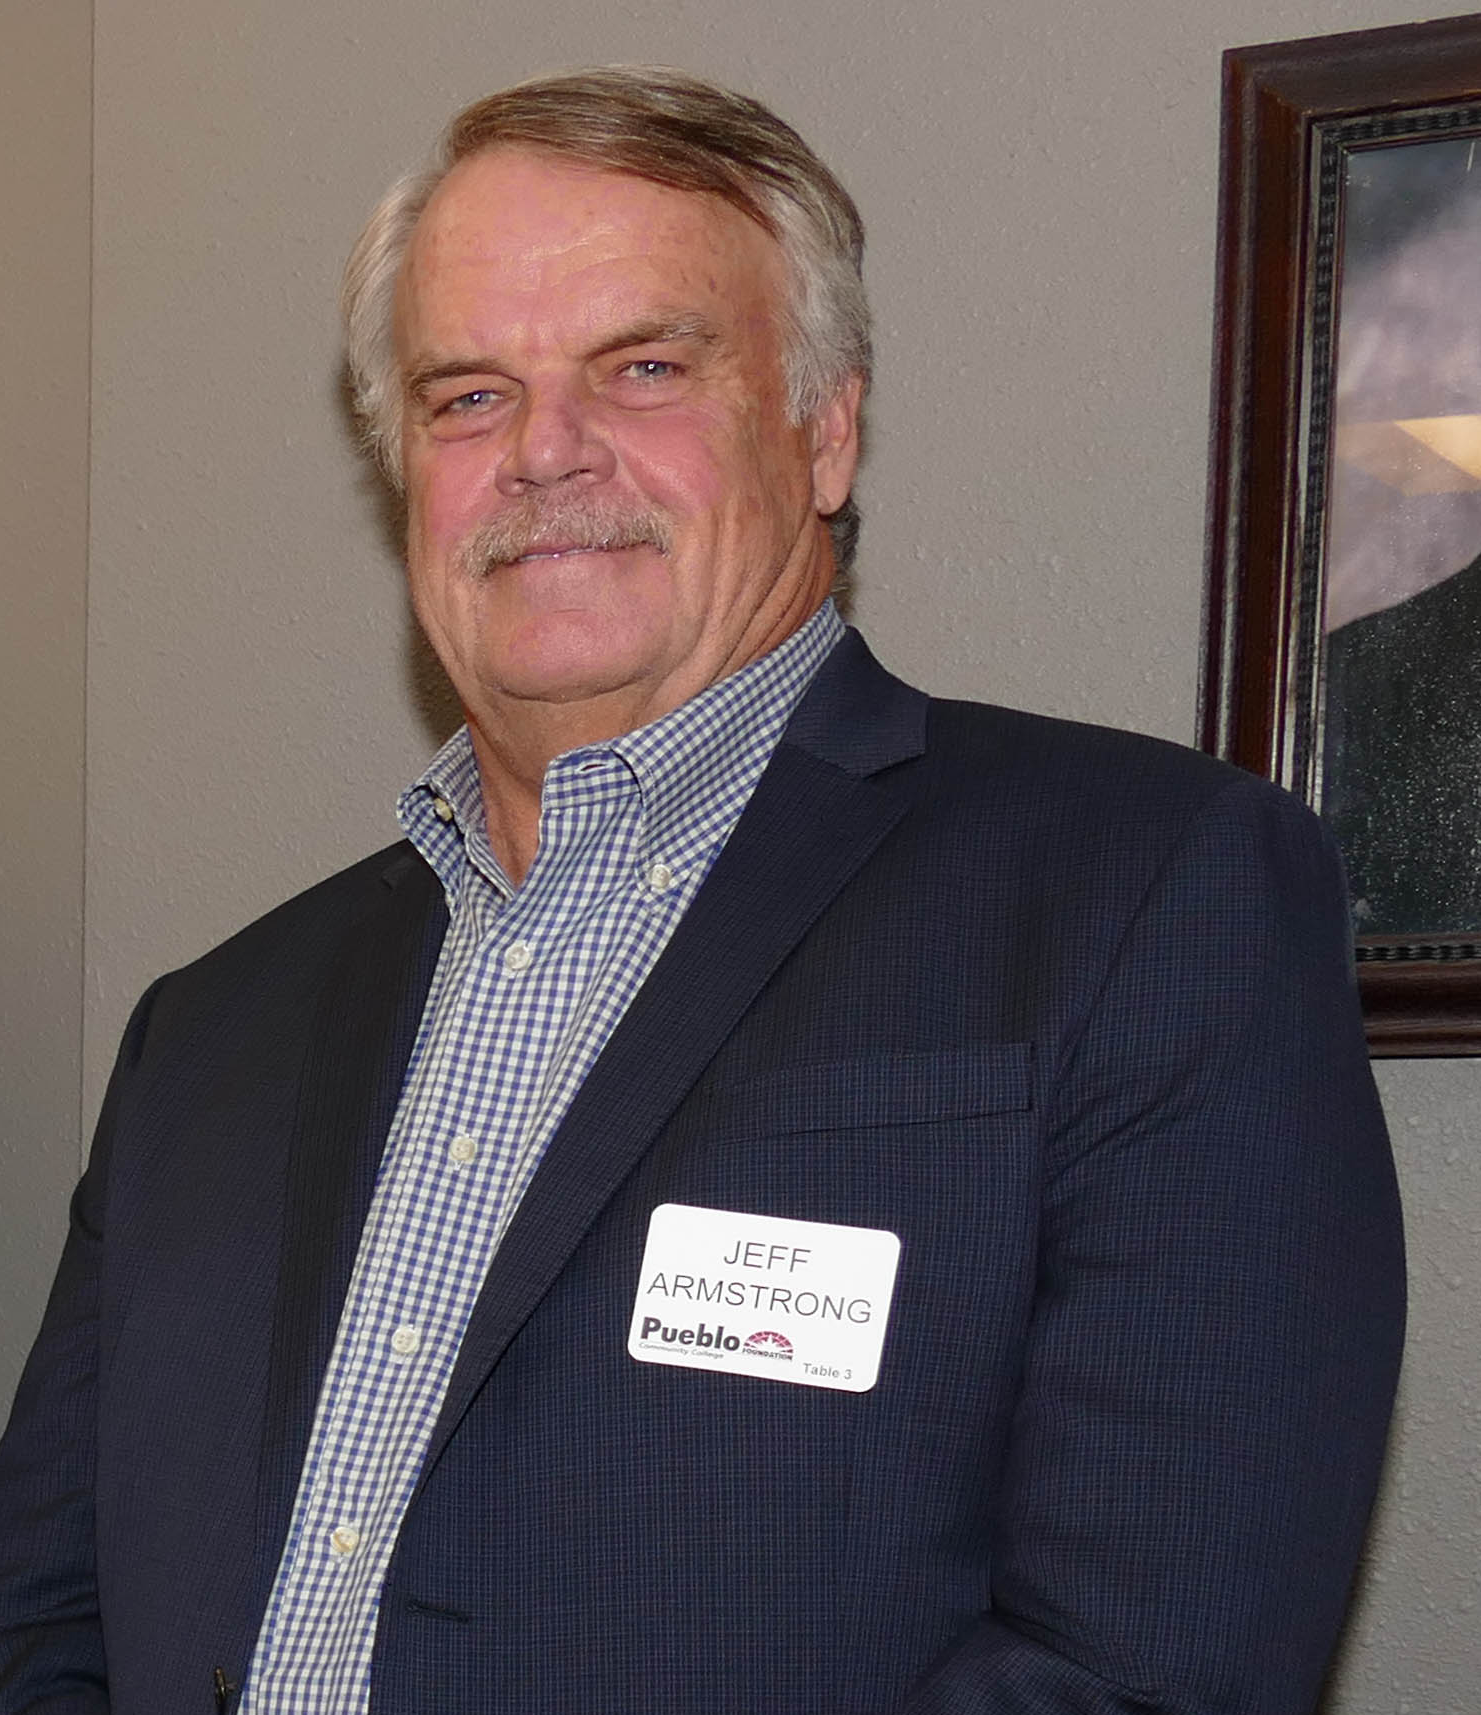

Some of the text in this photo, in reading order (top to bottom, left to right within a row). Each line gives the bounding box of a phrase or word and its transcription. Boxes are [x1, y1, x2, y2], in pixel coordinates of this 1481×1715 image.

[723, 1240, 812, 1273] JEFF
[646, 1272, 872, 1324] ARMSTRONG
[640, 1316, 740, 1351] Pueblo
[741, 1346, 794, 1361] FOUNDATION
[802, 1362, 853, 1380] Table 3
